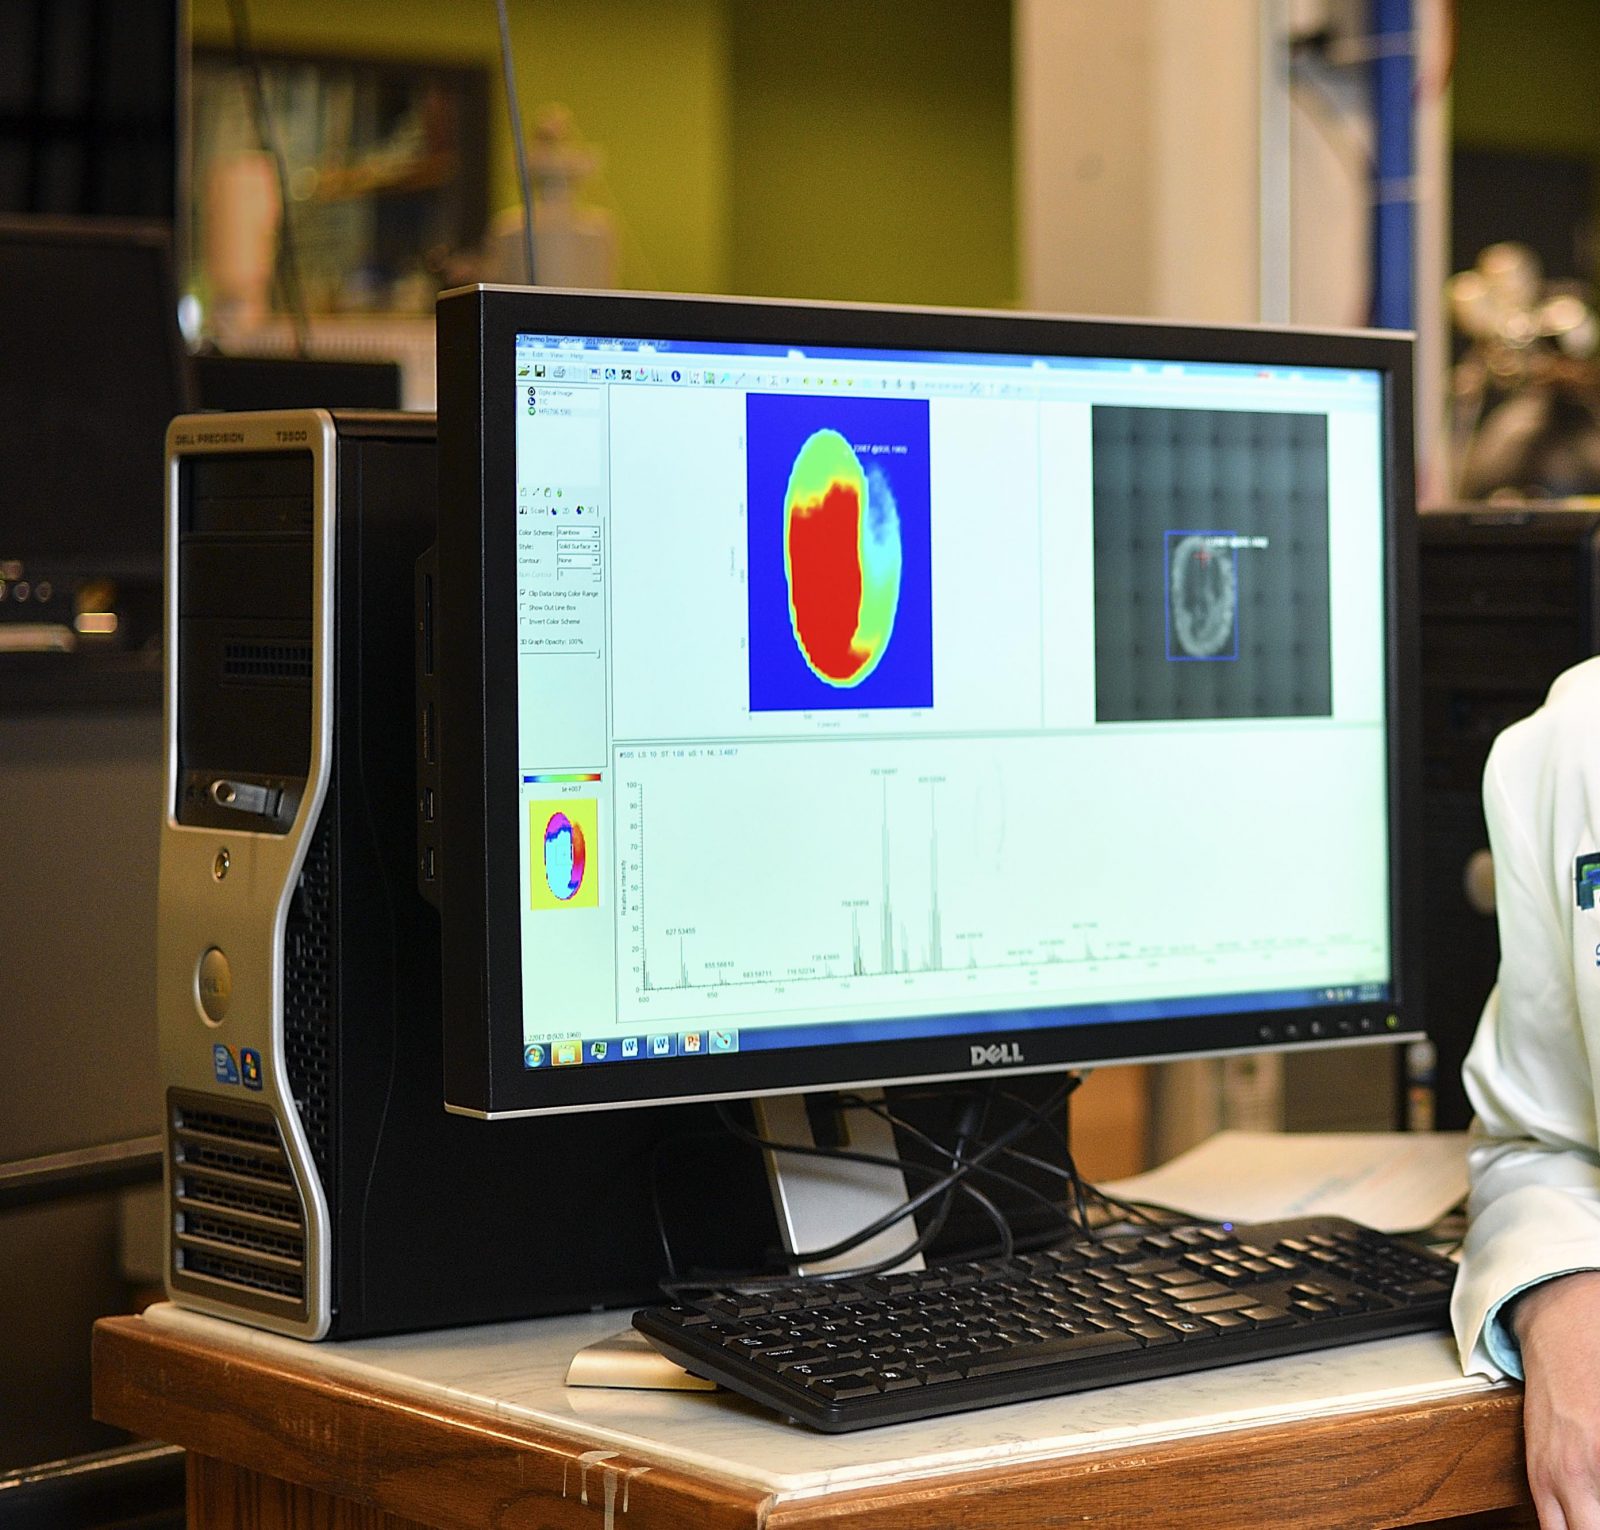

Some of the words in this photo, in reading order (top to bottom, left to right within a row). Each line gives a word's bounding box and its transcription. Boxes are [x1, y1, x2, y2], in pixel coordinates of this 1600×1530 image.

[518, 543, 534, 551] Style:
[528, 590, 539, 598] Clip
[552, 590, 567, 598] Using
[582, 590, 599, 598] Range
[528, 638, 544, 646] Graph
[544, 638, 566, 646] Opacity:
[970, 1042, 1024, 1066] DELL
